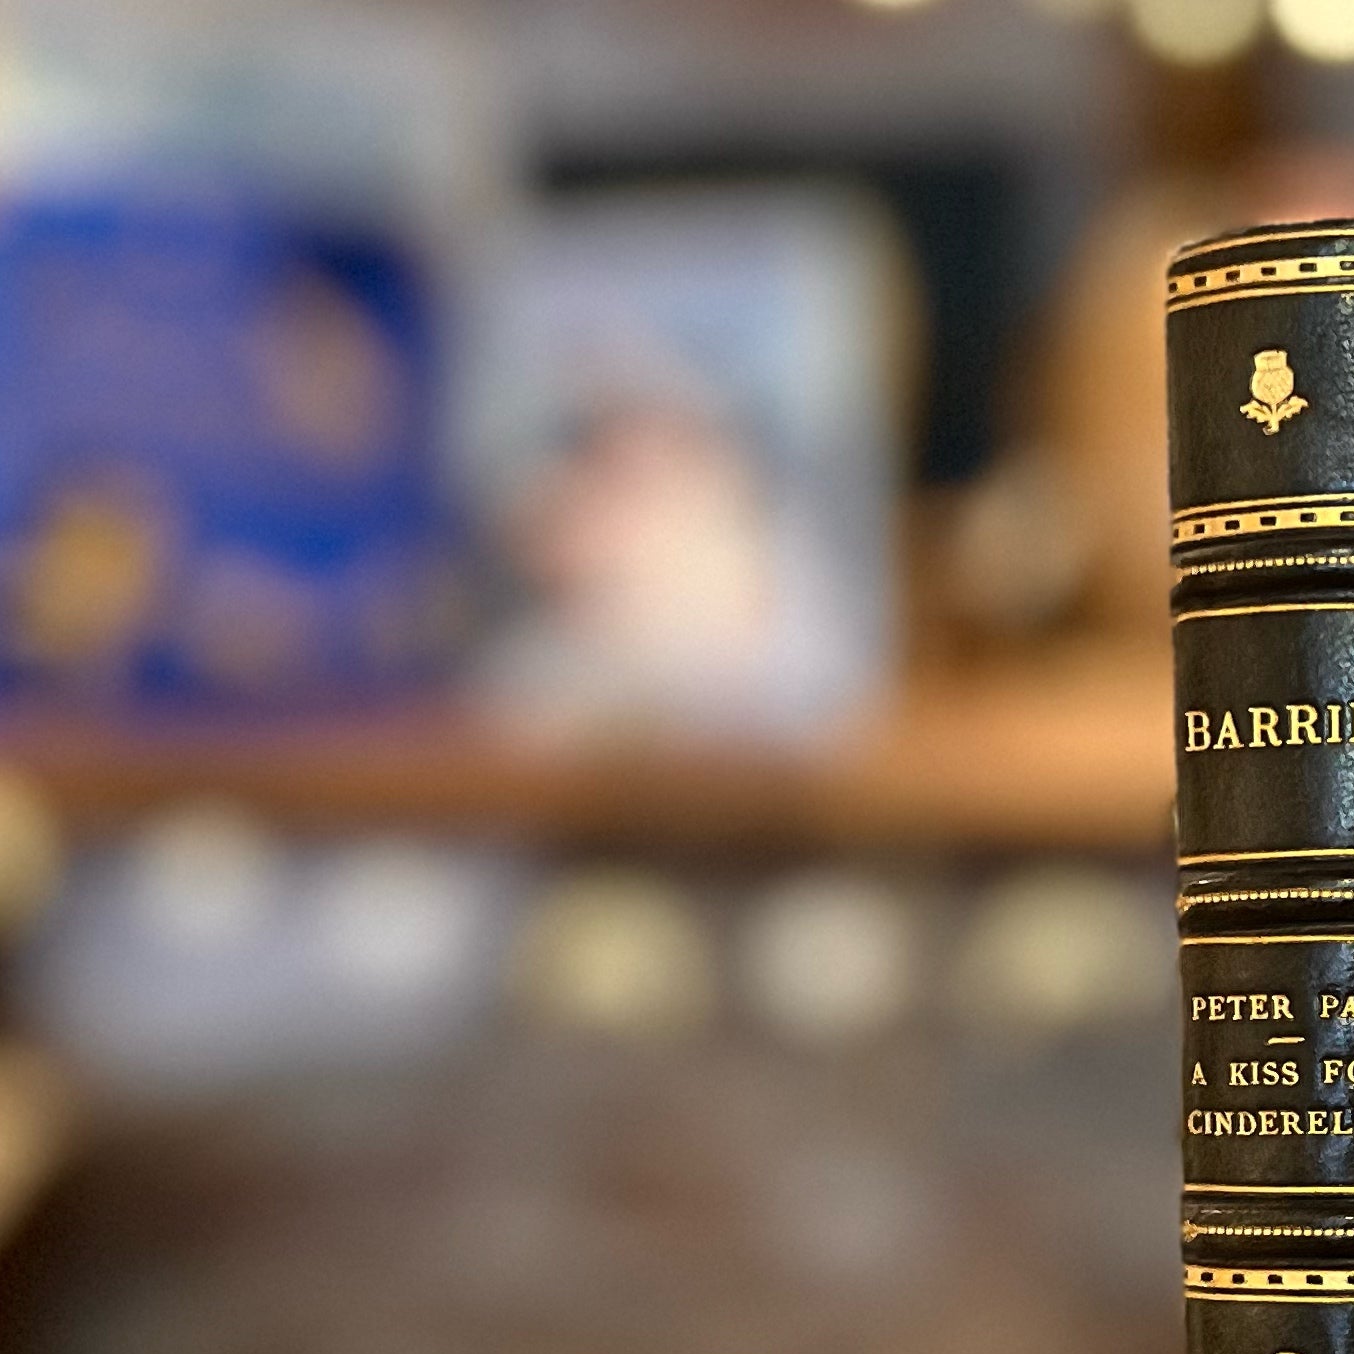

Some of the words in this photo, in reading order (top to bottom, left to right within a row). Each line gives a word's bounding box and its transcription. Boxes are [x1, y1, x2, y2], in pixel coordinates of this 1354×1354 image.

[1191, 993, 1295, 1021] PETER
[1191, 1061, 1208, 1086] A
[1228, 1061, 1300, 1087] KISS
